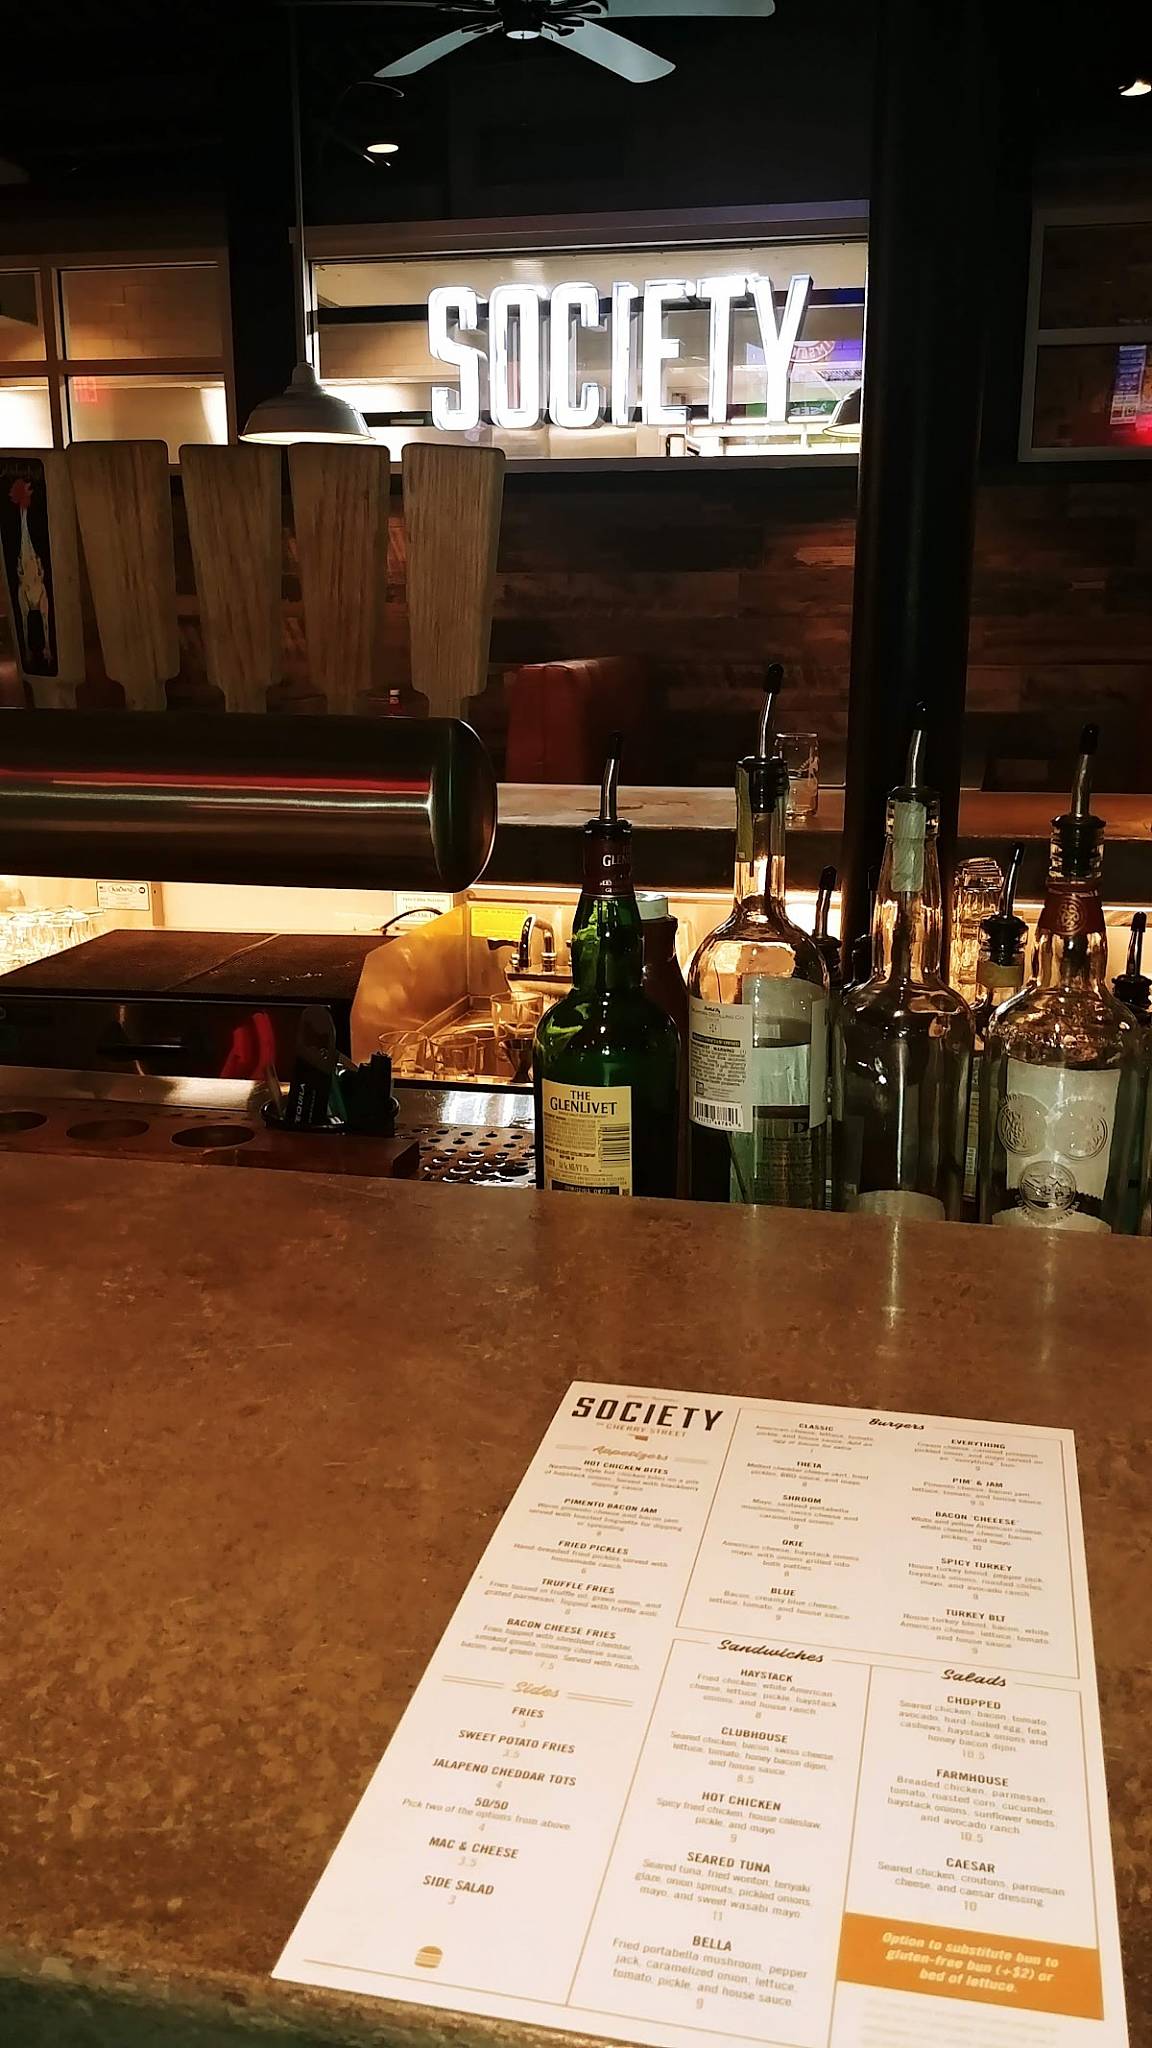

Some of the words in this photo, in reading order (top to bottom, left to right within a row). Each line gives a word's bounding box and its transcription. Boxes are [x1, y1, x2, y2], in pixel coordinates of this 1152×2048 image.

[428, 274, 813, 431] SOCIETY
[570, 1090, 591, 1100] THE
[550, 1097, 617, 1115] GLENLIVET
[571, 1396, 722, 1431] SOCIETY
[798, 1423, 833, 1431] CLASSIC
[868, 1418, 924, 1432] Burgers
[951, 1439, 1005, 1449] EVERYTHING
[592, 1445, 668, 1461] Appetizers
[603, 1462, 641, 1471] CHICKEN
[643, 1467, 668, 1475] BITES
[796, 1461, 821, 1469] THETA
[564, 1498, 604, 1507] PIMENTO
[606, 1503, 638, 1511] BACON
[783, 1494, 821, 1504] SHROOM
[935, 1511, 967, 1520] BACON
[558, 1540, 587, 1549] FRIED
[588, 1544, 628, 1555] PICKLES
[782, 1539, 802, 1547] OKIE
[941, 1558, 970, 1567] SPICY
[974, 1561, 1012, 1572] TURKEY
[542, 1578, 583, 1590] TRUFFLE
[585, 1584, 614, 1594] FRIES
[770, 1587, 795, 1596] BLUE
[946, 1608, 984, 1620] TURKEY
[988, 1614, 1005, 1622] BLT
[506, 1618, 542, 1629] BACON
[543, 1623, 581, 1635] CHEESE
[585, 1628, 616, 1639] FRIES
[718, 1640, 823, 1663] Sandwiches
[740, 1668, 792, 1682] HAYSTACK
[941, 1669, 1006, 1687] Salads
[511, 1681, 560, 1698] Sides
[947, 1695, 1000, 1710] CHOPPED
[511, 1706, 544, 1718] FRIES
[458, 1730, 496, 1742] SWEET
[497, 1735, 539, 1748] POTATO
[541, 1741, 575, 1754] FRIES
[721, 1726, 788, 1743] CLUBHOUSE
[432, 1758, 488, 1774] JALAPENO
[491, 1766, 546, 1782] CHEDDAR
[549, 1774, 576, 1786] TOTS
[936, 1769, 1008, 1787] FARMHOUSE
[402, 1798, 423, 1808] Pick
[455, 1806, 474, 1816] the
[474, 1797, 509, 1810] 50/50
[701, 1791, 724, 1803] HOT
[728, 1795, 781, 1811] CHICKEN
[428, 1836, 456, 1849] MAC
[458, 1841, 467, 1851] &
[471, 1843, 518, 1859] CHEESE
[687, 1851, 735, 1868] SEARED
[740, 1859, 770, 1873] TUNA
[946, 1857, 995, 1873] CAESAR
[422, 1875, 452, 1888] SIDE
[455, 1880, 494, 1895] SALAD
[692, 1935, 731, 1951] BELLA
[882, 1932, 925, 1948] Option
[927, 1939, 942, 1950] to
[944, 1943, 1012, 1961] substitute
[1013, 1952, 1042, 1965] bun
[1044, 1956, 1059, 1968] to
[612, 1937, 640, 1951] Fried
[768, 1965, 808, 1978] pepper
[885, 1948, 965, 1971] gluten-free
[965, 1959, 993, 1973] bun
[994, 1963, 1035, 1981] (+$2)
[1037, 1972, 1053, 1982] or
[919, 1967, 947, 1982] bed
[947, 1971, 964, 1985] of
[965, 1974, 1016, 1992] lettuce.
[696, 1984, 719, 1994] and
[721, 1986, 755, 2000] house
